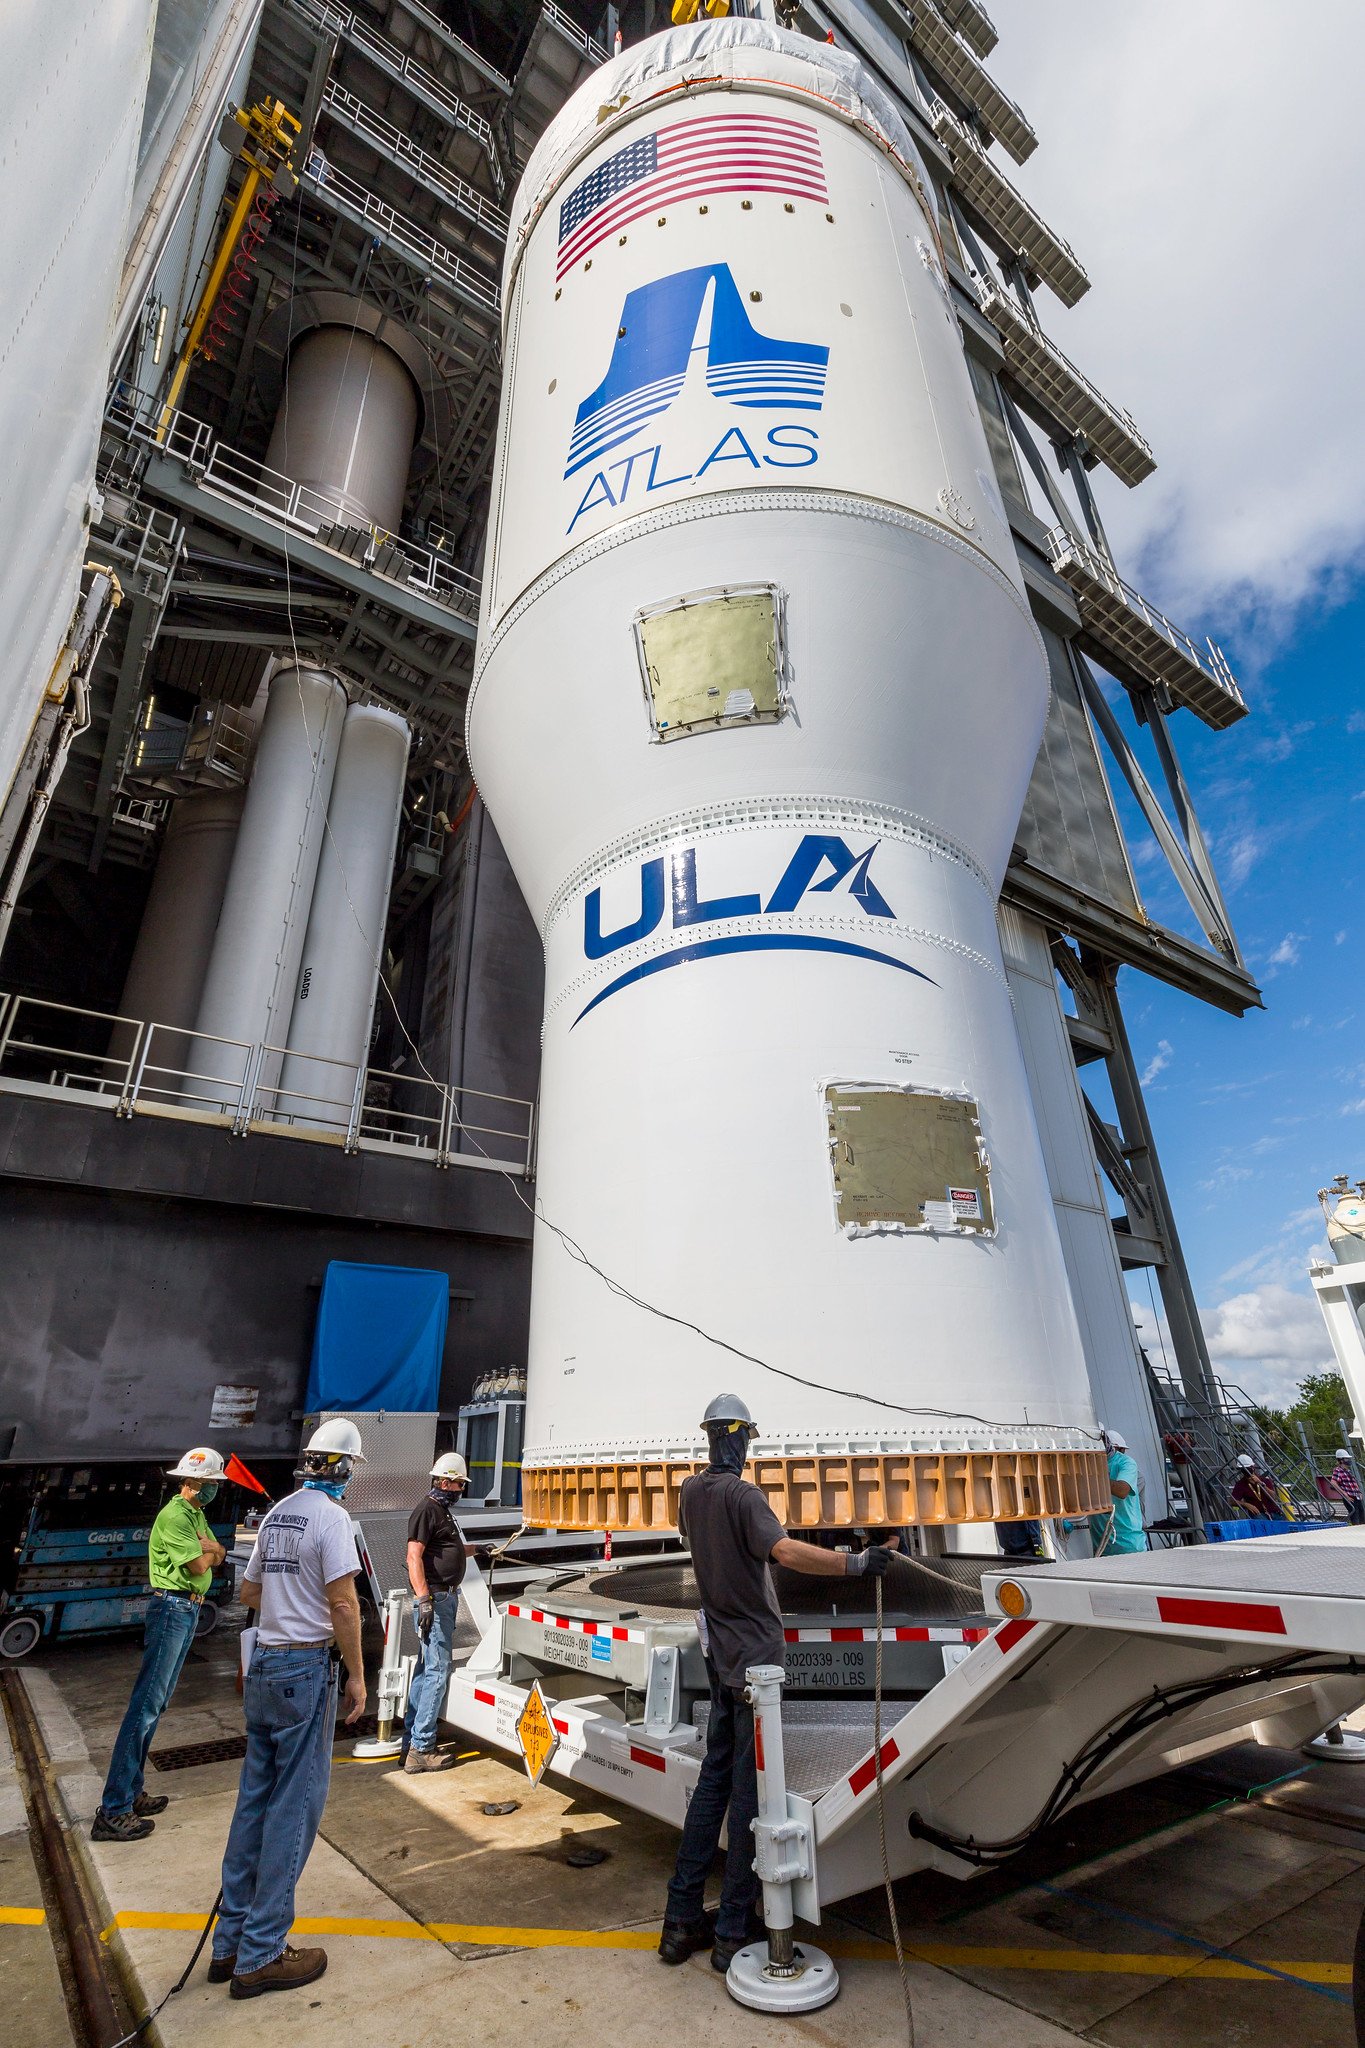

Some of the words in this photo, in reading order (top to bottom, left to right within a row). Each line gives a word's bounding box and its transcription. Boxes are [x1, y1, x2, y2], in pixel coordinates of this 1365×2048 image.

[566, 425, 820, 535] ATLAS
[584, 834, 897, 960] ULA
[300, 967, 313, 1000] LOADED
[88, 1531, 125, 1543] Genie
[578, 1638, 589, 1651] 009
[544, 1645, 564, 1661] WEIGHT
[564, 1651, 577, 1666] 4400
[577, 1654, 588, 1668] LBS
[785, 1652, 833, 1667] 3020339
[843, 1652, 864, 1666] 009
[783, 1672, 808, 1686] GHT
[811, 1671, 839, 1686] 4400
[842, 1671, 866, 1686] LBS
[523, 1721, 549, 1739] EXPLOSIVES
[592, 1755, 606, 1767] LOADED
[620, 1766, 634, 1779] EMPTY
